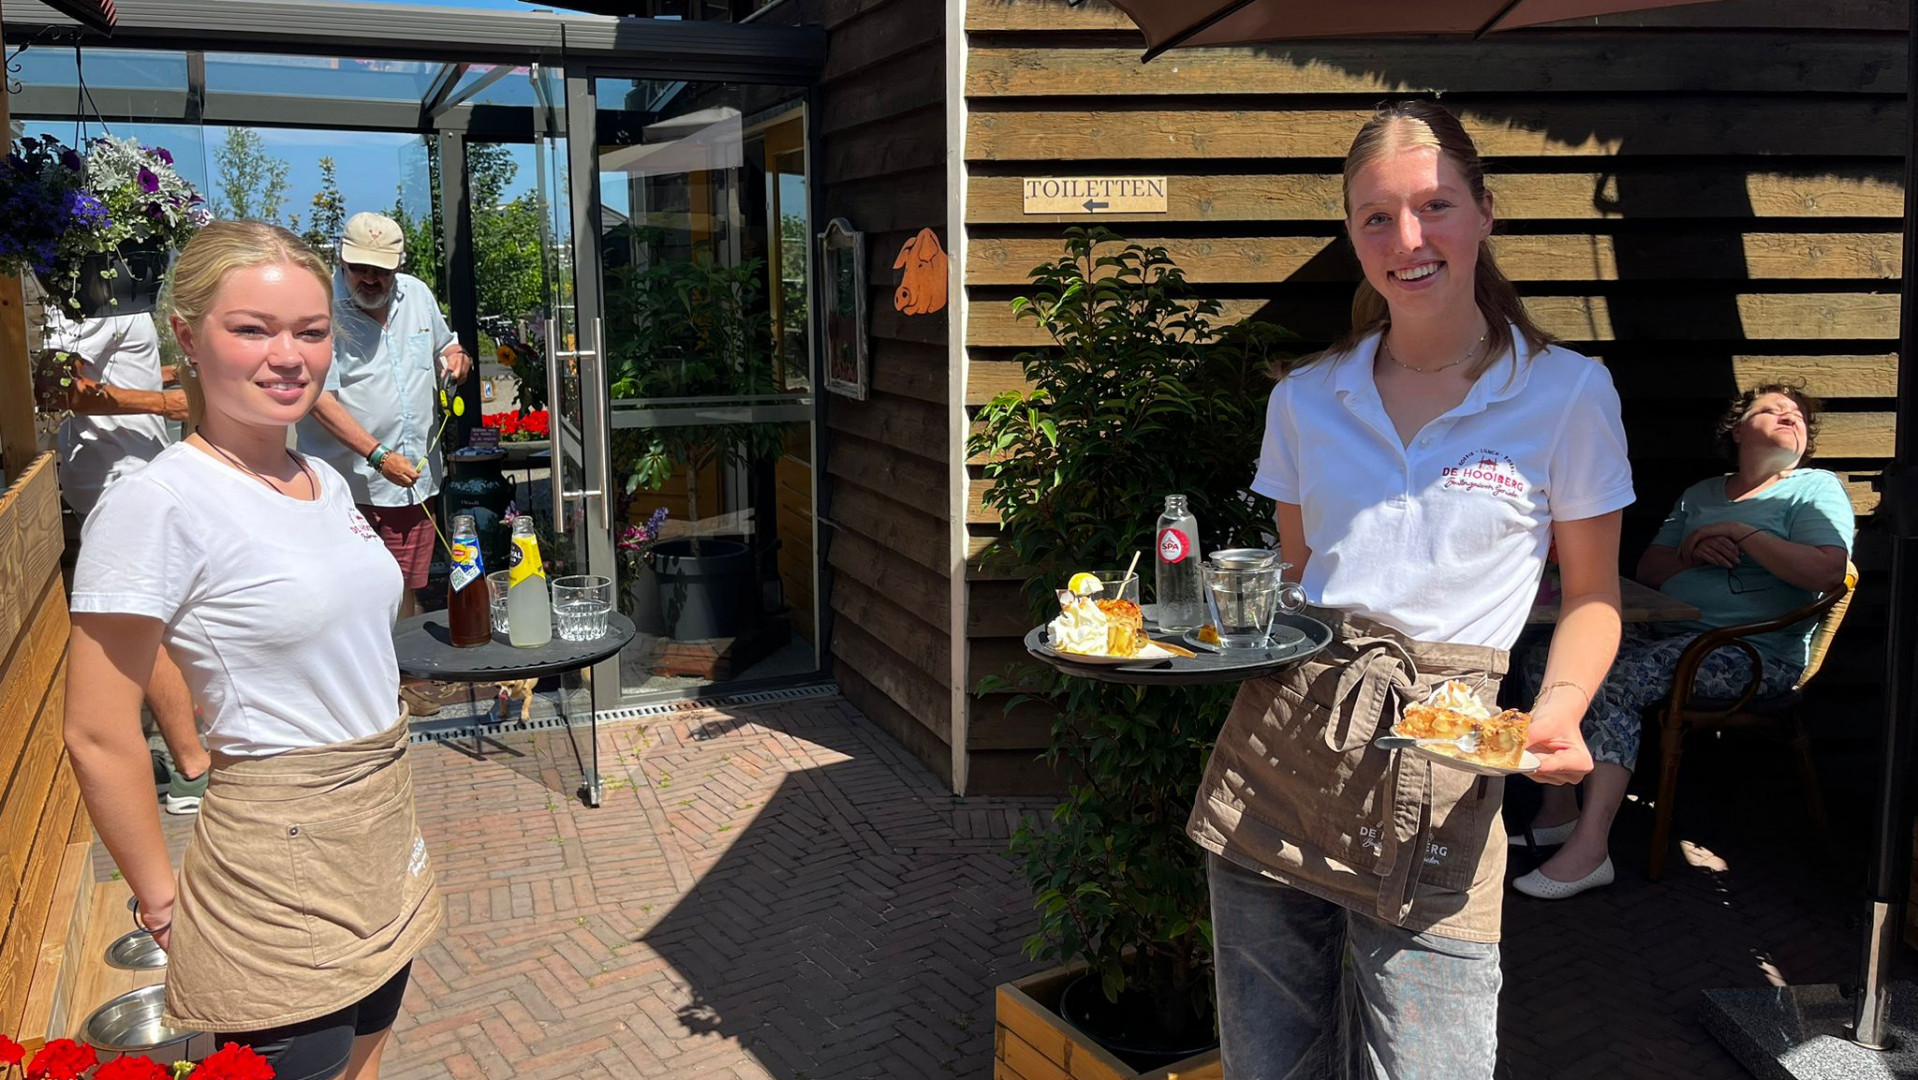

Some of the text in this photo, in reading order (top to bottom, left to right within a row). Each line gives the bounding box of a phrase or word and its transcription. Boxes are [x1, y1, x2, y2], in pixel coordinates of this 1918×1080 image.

[1027, 179, 1164, 198] TOILETTEN
[1442, 467, 1524, 492] DE HOOIBERG
[1360, 826, 1377, 838] DE
